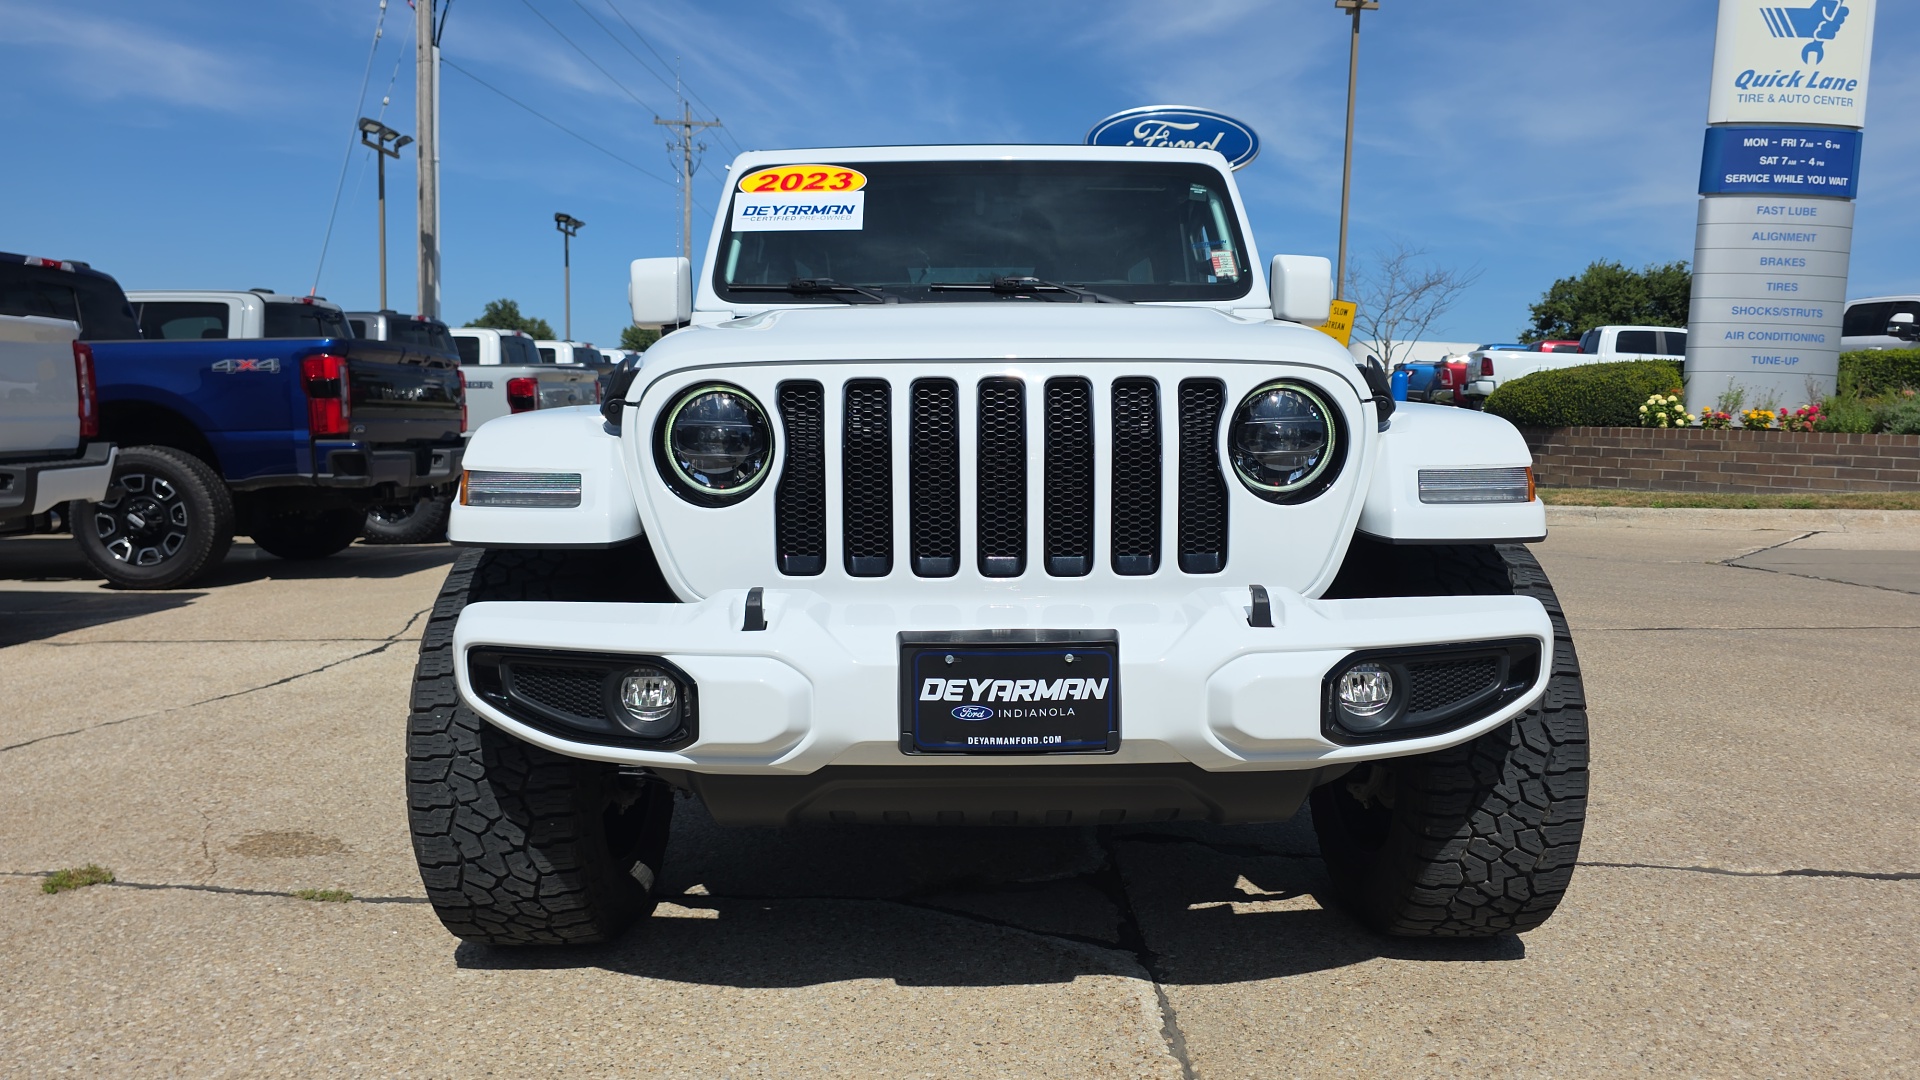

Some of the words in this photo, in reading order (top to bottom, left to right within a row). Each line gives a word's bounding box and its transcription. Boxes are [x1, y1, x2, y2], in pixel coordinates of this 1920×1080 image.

[1735, 69, 1805, 90] Quick
[1805, 71, 1858, 92] Lane
[1737, 93, 1764, 103] TIRE
[1767, 94, 1775, 103] &
[1778, 94, 1810, 104] AUTO
[1813, 95, 1853, 107] CENTER
[1743, 138, 1768, 147] MON
[1781, 138, 1797, 147] FRI
[1759, 156, 1779, 165] SAT
[753, 172, 854, 192] 2023
[1725, 174, 1770, 183] SERVICE
[1773, 174, 1804, 183] WHILE
[1807, 175, 1826, 185] YOU
[1828, 176, 1848, 186] WAIT
[742, 204, 856, 216] DEYARMAN
[1756, 205, 1785, 216] FAST
[1788, 206, 1817, 217] LUBE
[1752, 231, 1817, 243] ALIGNMENT
[1760, 256, 1806, 267] BRAKES
[1766, 282, 1798, 292] TIRES
[1333, 307, 1349, 316] SLOW
[1731, 306, 1823, 319] SHOCKS/STRUTS
[1321, 321, 1345, 330] STRIAN
[1724, 331, 1744, 341] AIR
[1747, 331, 1825, 343] CONDITIONING
[1751, 355, 1799, 366] TUNE-UP
[920, 677, 1109, 702] DEYARMAN
[999, 707, 1075, 718] INDIANOLA
[967, 735, 1062, 745] DEYARMANFORD.COM
